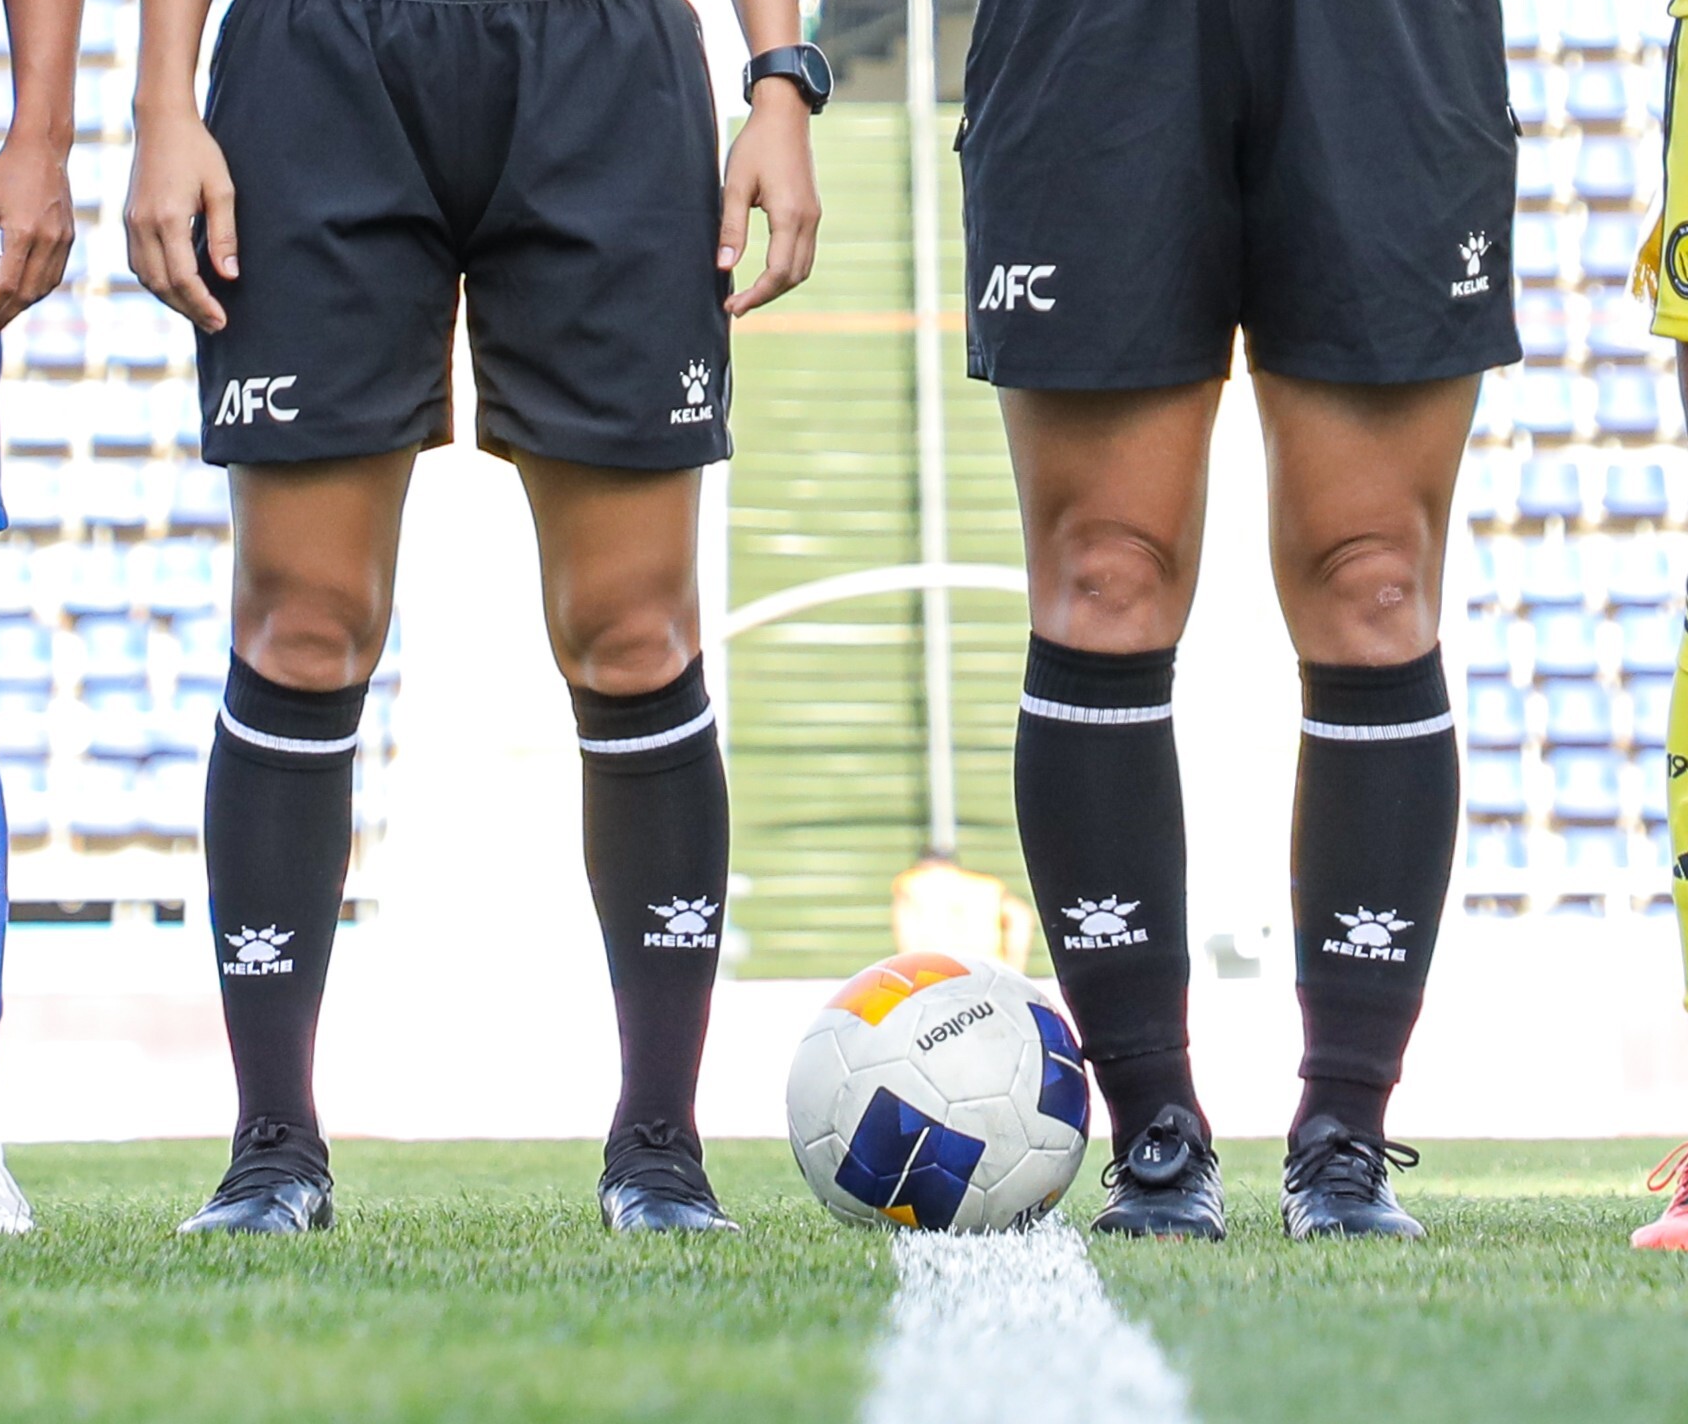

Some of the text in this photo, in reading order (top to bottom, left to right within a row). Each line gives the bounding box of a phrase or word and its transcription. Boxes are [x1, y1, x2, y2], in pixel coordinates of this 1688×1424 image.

[978, 264, 1057, 312] AFC
[214, 375, 300, 426] AFC
[643, 931, 716, 949] KELME
[1063, 928, 1149, 951] KELME
[1322, 938, 1408, 962] KELME
[223, 958, 293, 976] KELME
[915, 1000, 995, 1054] molten
